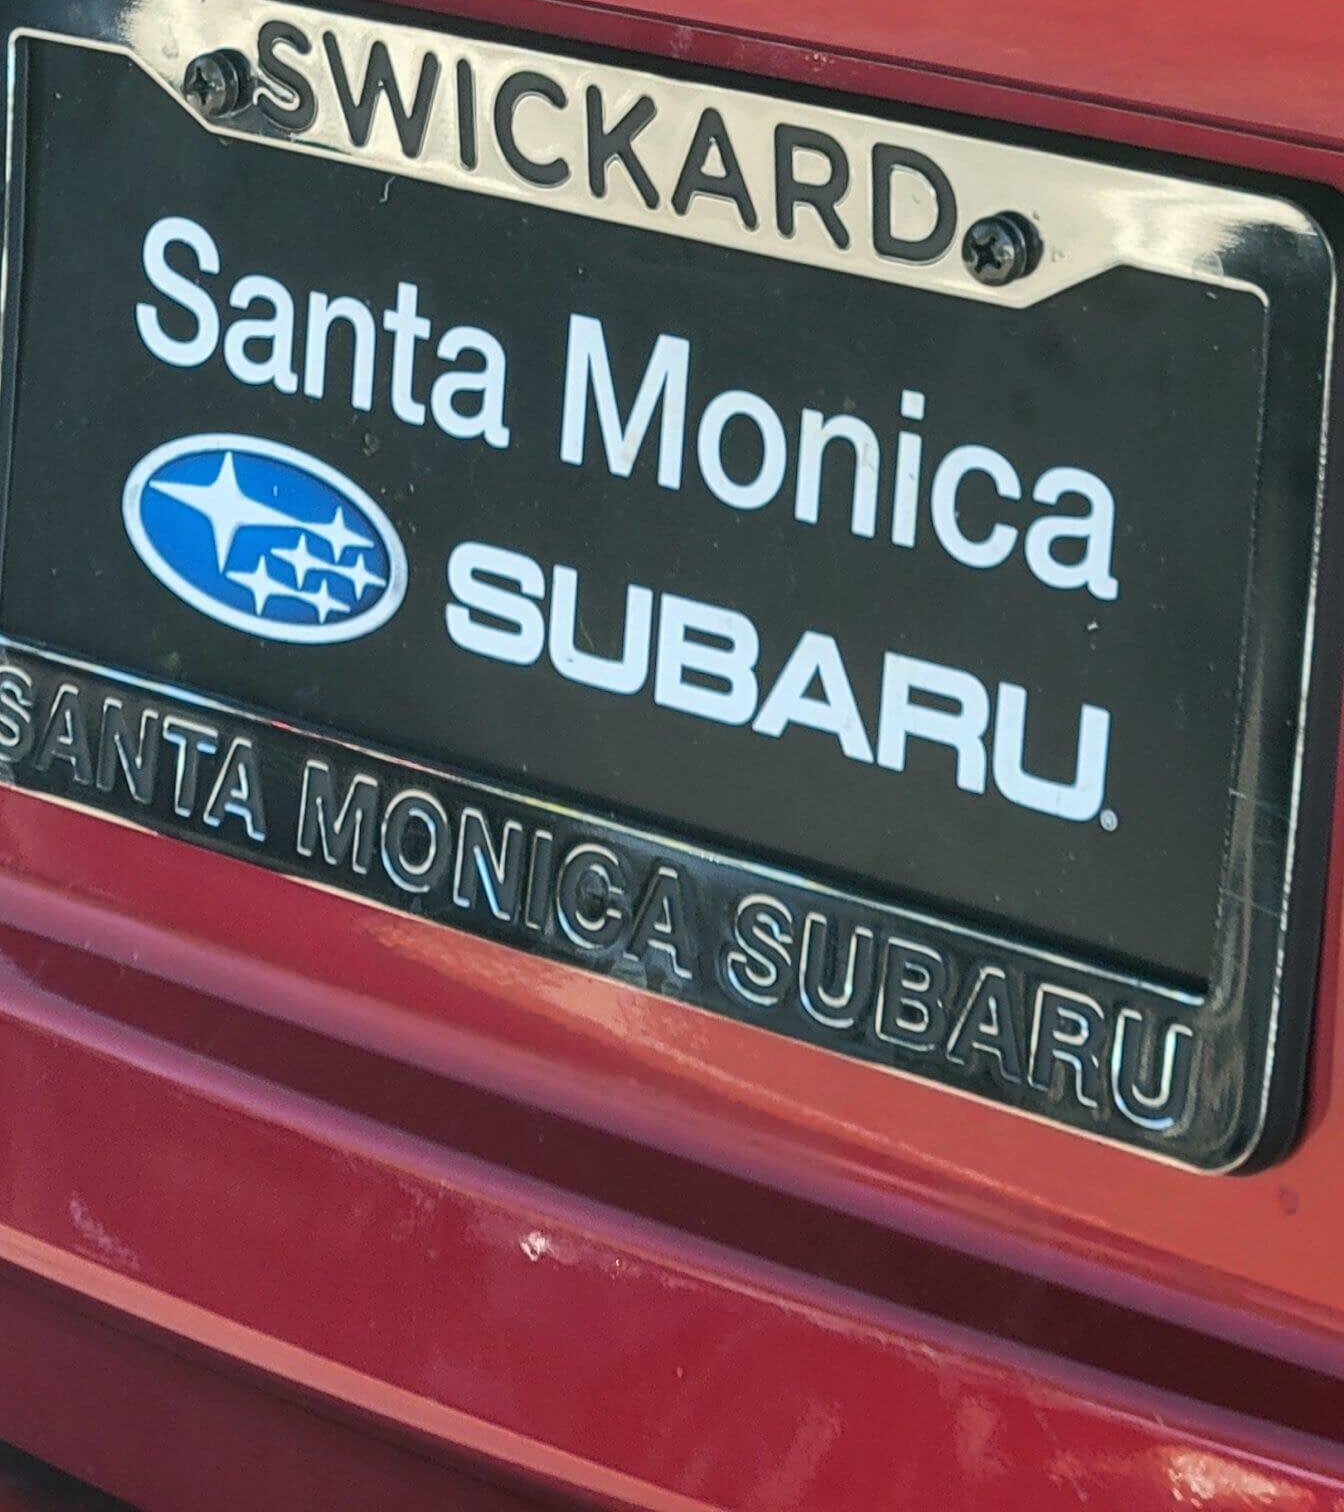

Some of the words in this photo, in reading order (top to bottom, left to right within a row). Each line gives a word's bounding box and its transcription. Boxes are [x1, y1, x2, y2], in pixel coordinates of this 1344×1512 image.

[254, 20, 958, 266] SWICKARD
[135, 216, 510, 448] Santa
[560, 313, 1119, 600] Monica
[445, 541, 1111, 822] SUBARU
[296, 759, 694, 979] MONICA
[726, 894, 1196, 1132] SUBARU
